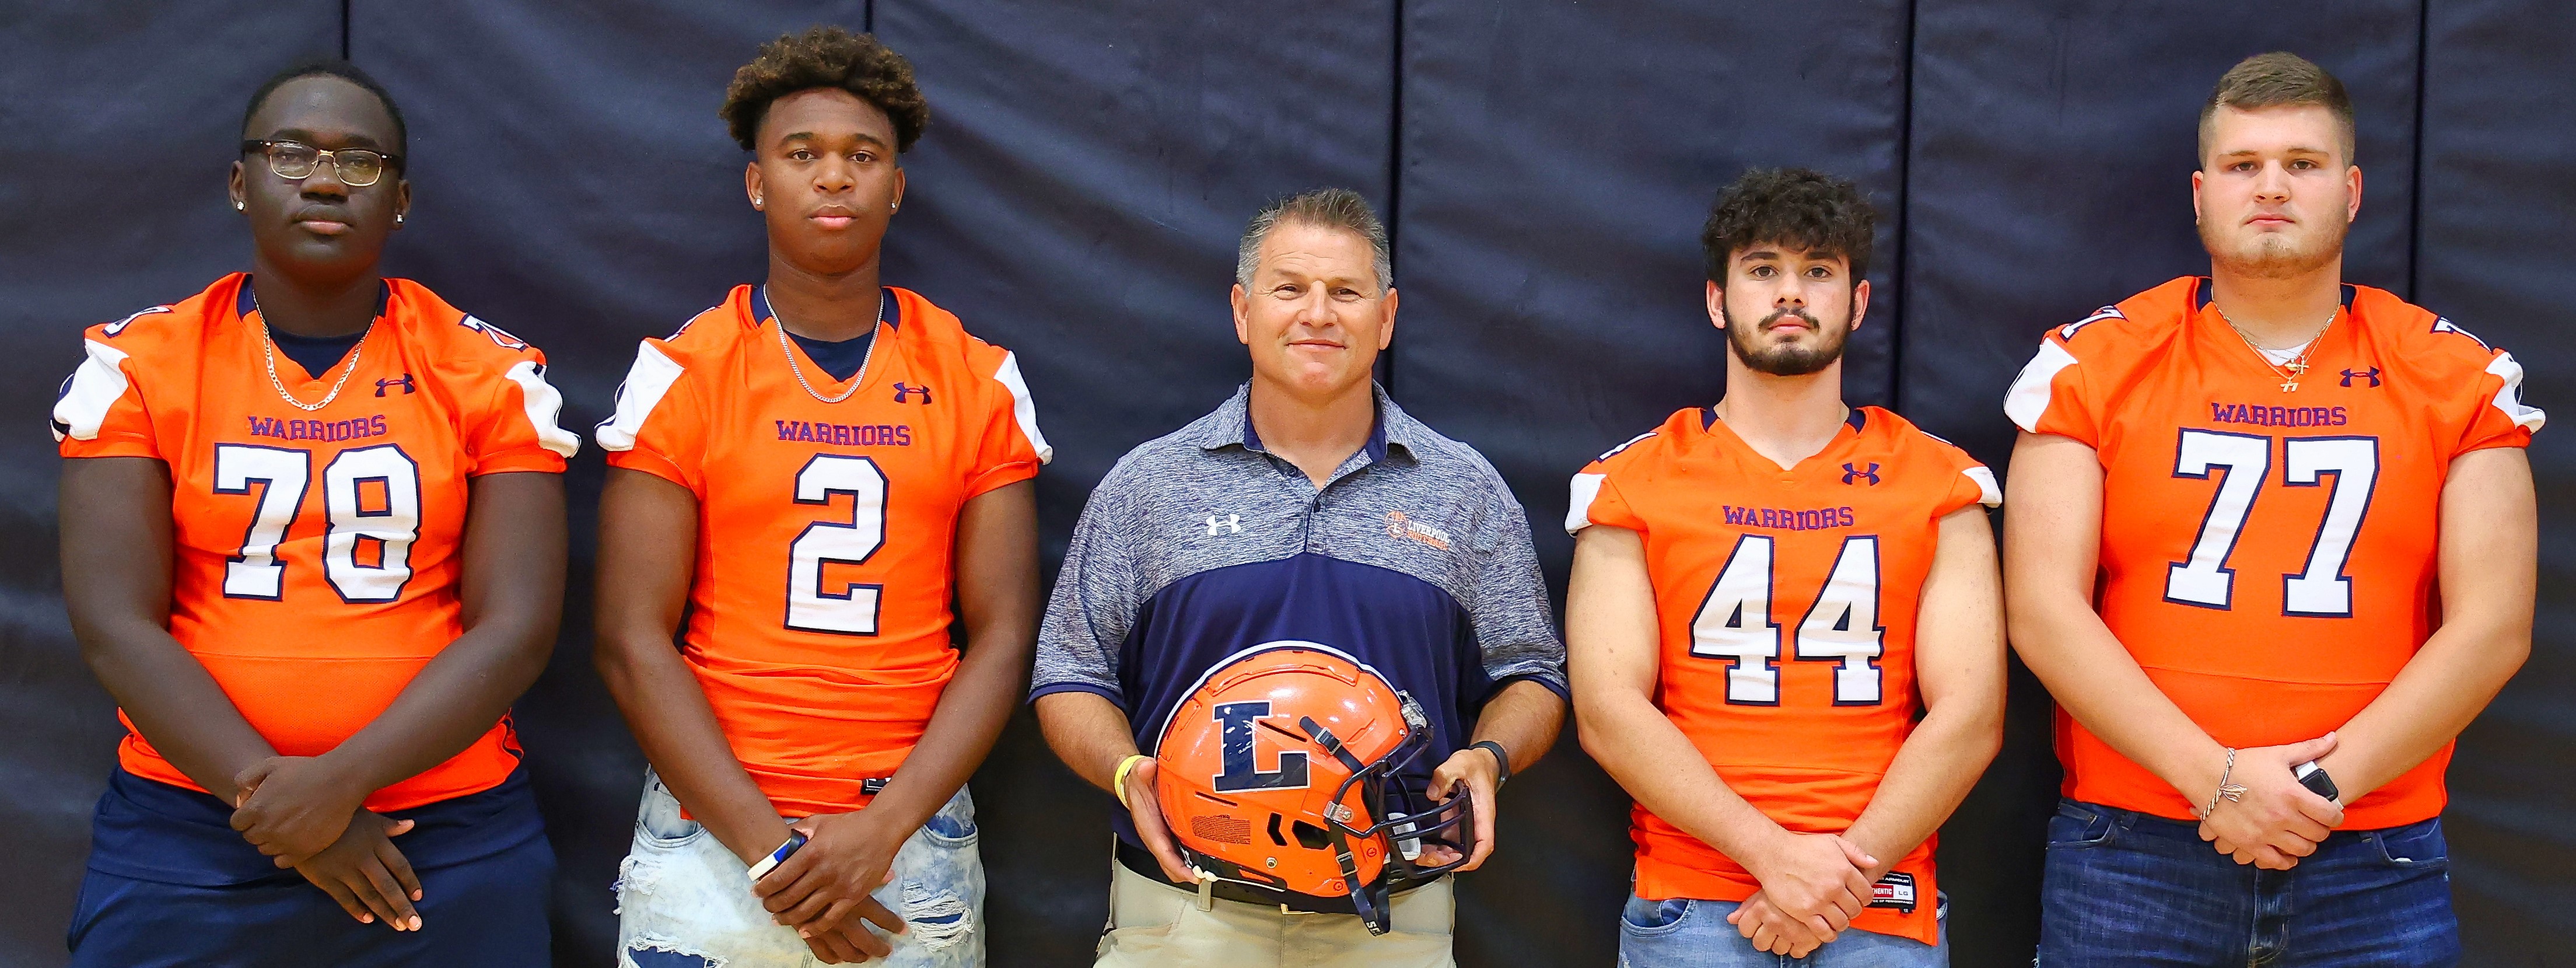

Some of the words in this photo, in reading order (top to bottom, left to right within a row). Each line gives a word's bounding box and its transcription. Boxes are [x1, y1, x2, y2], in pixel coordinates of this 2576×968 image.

[248, 415, 387, 442] WARRIORS
[776, 420, 911, 446] WARRIORS
[2211, 403, 2347, 427] WARRIORS
[214, 443, 422, 603] 78
[784, 453, 890, 636] 2
[1407, 520, 1450, 543] LIVERPOOL
[1722, 505, 1855, 531] WARRIORS
[2162, 427, 2379, 618] 77
[1689, 533, 1887, 707] 44
[1212, 701, 1311, 794] L
